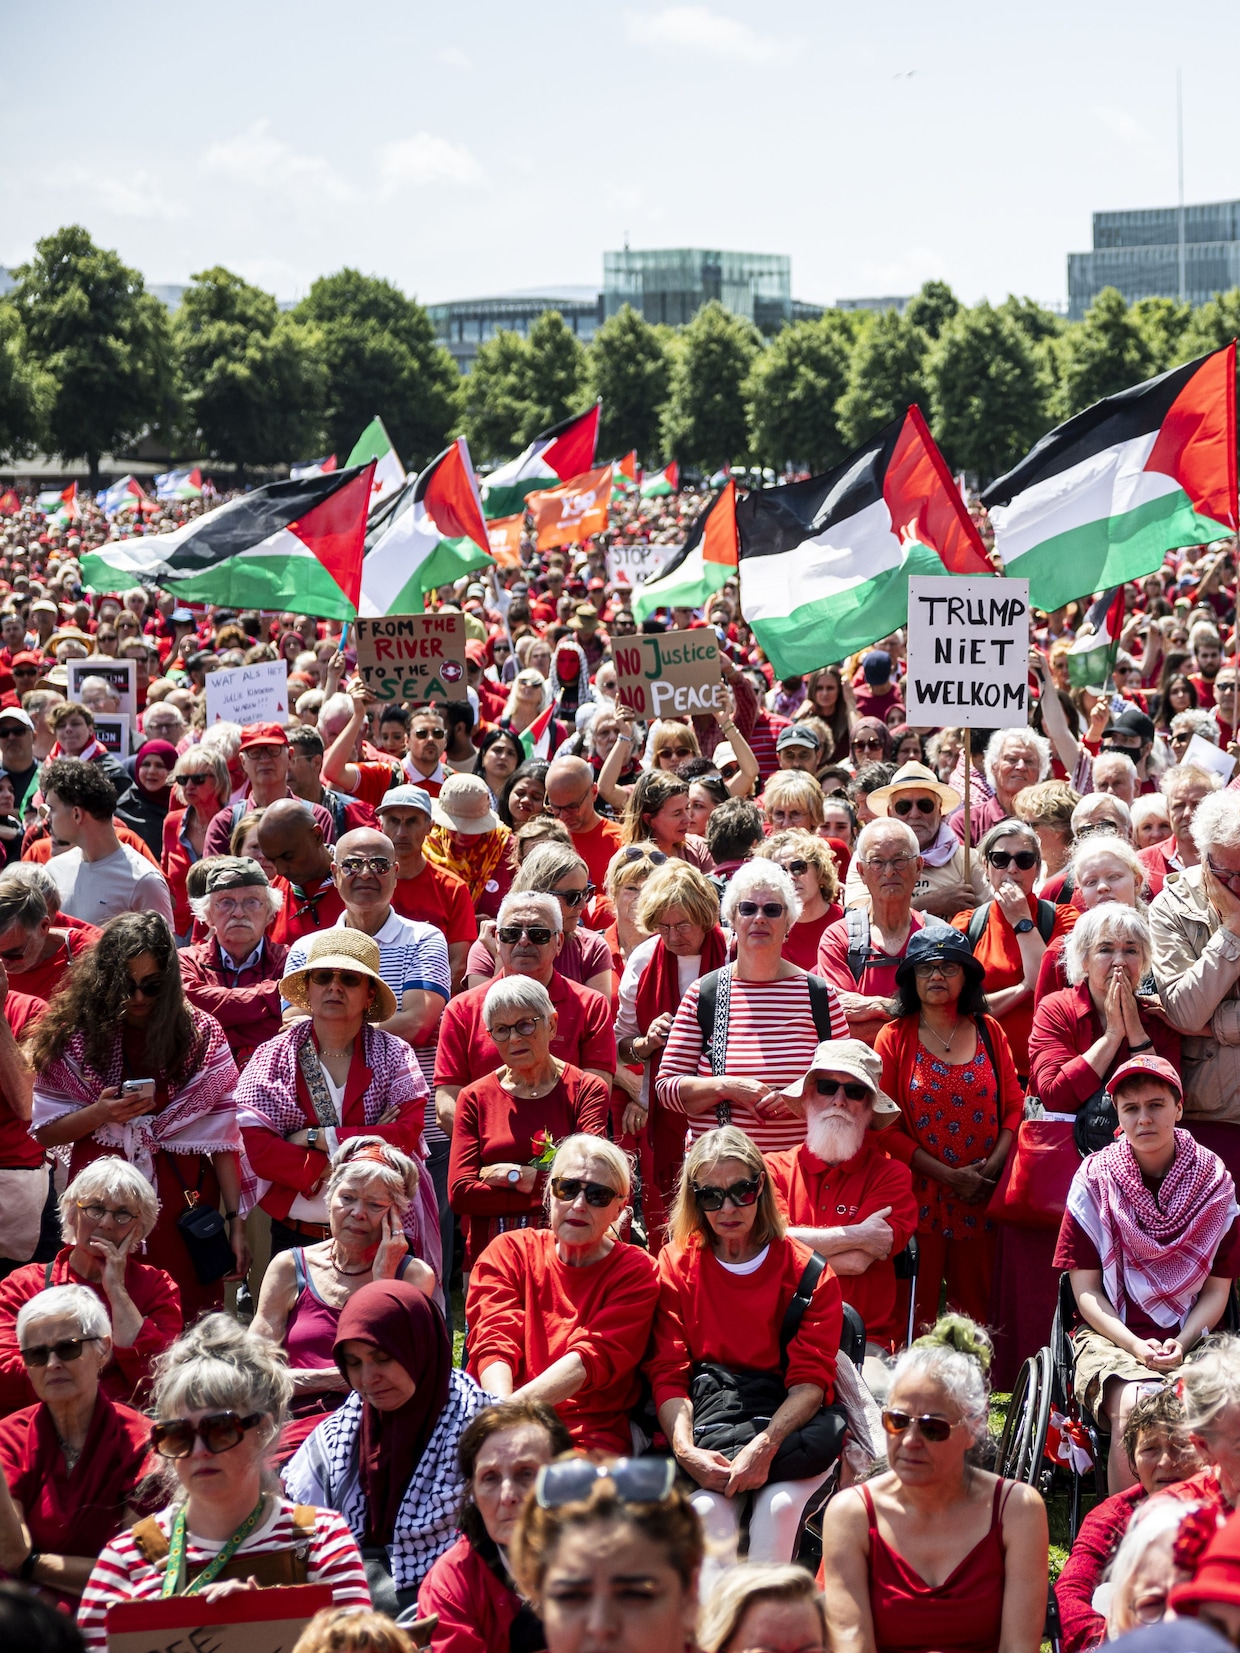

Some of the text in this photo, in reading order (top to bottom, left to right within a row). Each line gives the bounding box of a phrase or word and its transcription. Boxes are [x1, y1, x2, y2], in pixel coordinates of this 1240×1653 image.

[614, 548, 651, 565] STOP
[918, 596, 1026, 627] TRUMP
[357, 617, 456, 640] FROM THE
[615, 638, 717, 680] NO Justice
[211, 667, 283, 688] WAT ALS HET
[362, 664, 430, 682] TO THE
[375, 677, 447, 700] SEA
[619, 680, 723, 717] NO PEACE
[914, 679, 1026, 710] WELKOM
